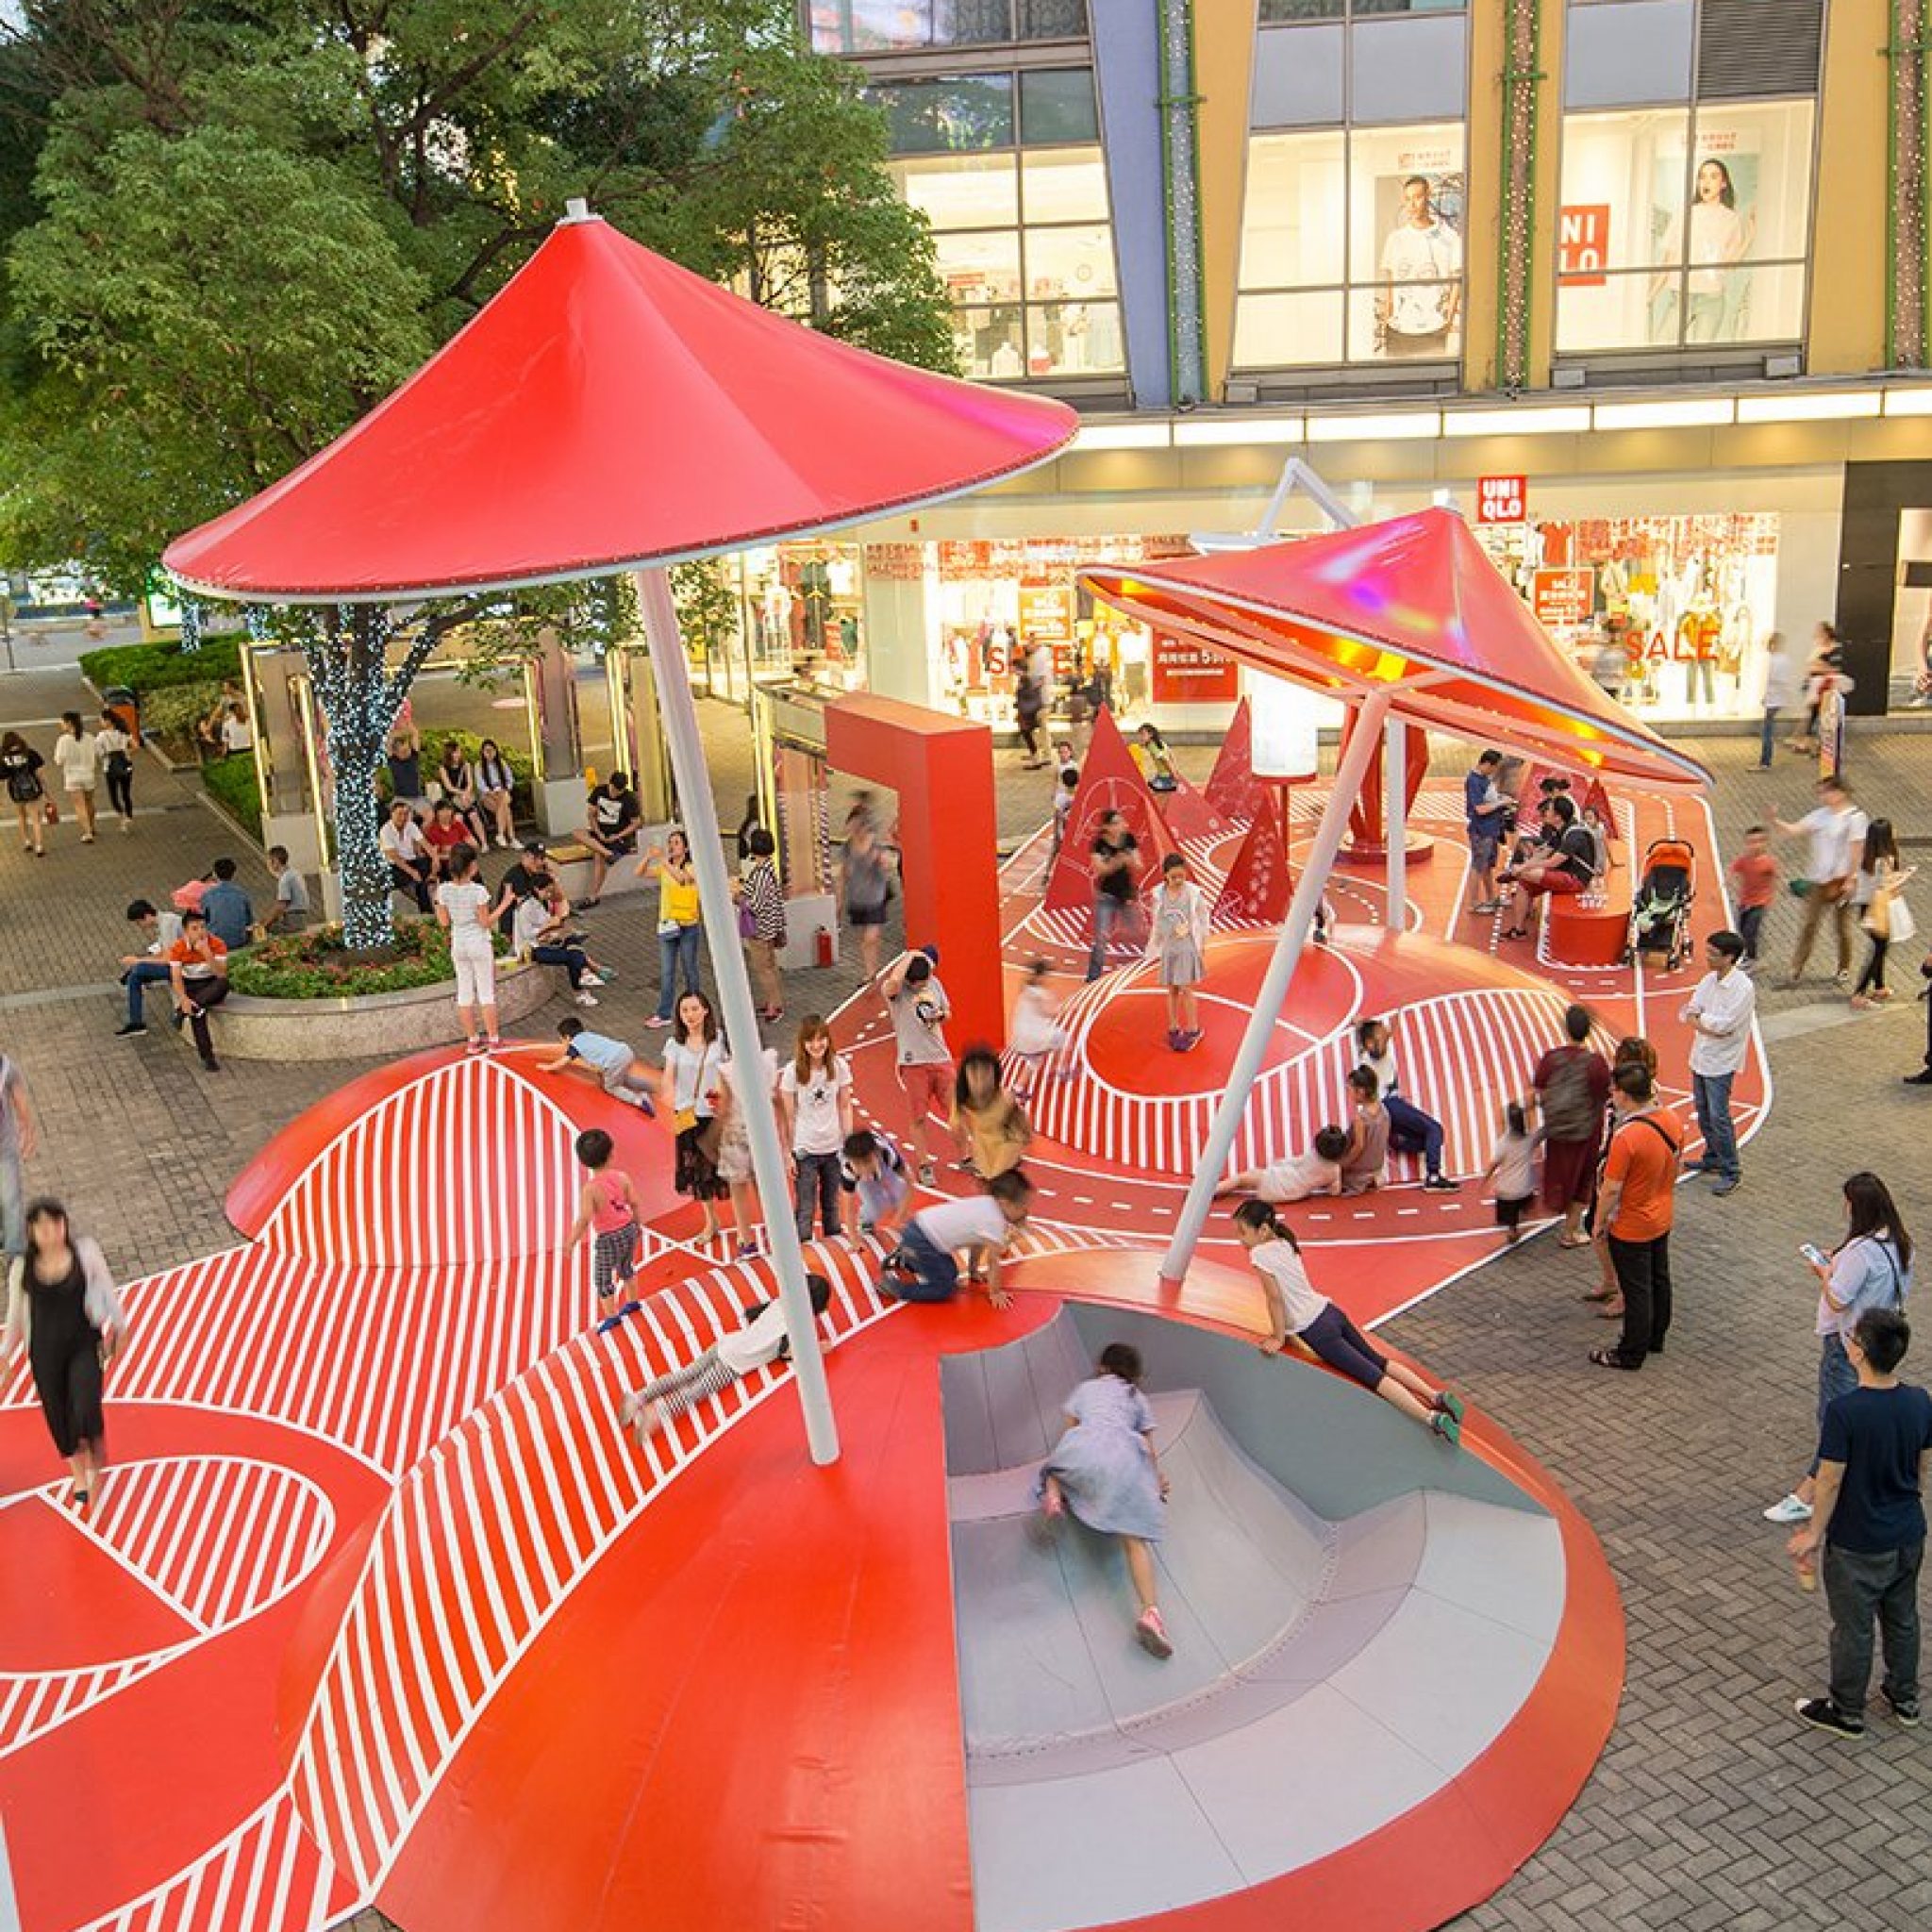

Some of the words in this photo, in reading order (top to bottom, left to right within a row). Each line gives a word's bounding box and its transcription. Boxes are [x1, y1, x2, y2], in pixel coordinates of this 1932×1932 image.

[1560, 214, 1595, 244] NI
[1560, 247, 1599, 273] LO
[1482, 479, 1520, 499] UNI
[1482, 499, 1522, 521] QLO
[1625, 629, 1720, 661] SALE
[987, 646, 1074, 675] SE
